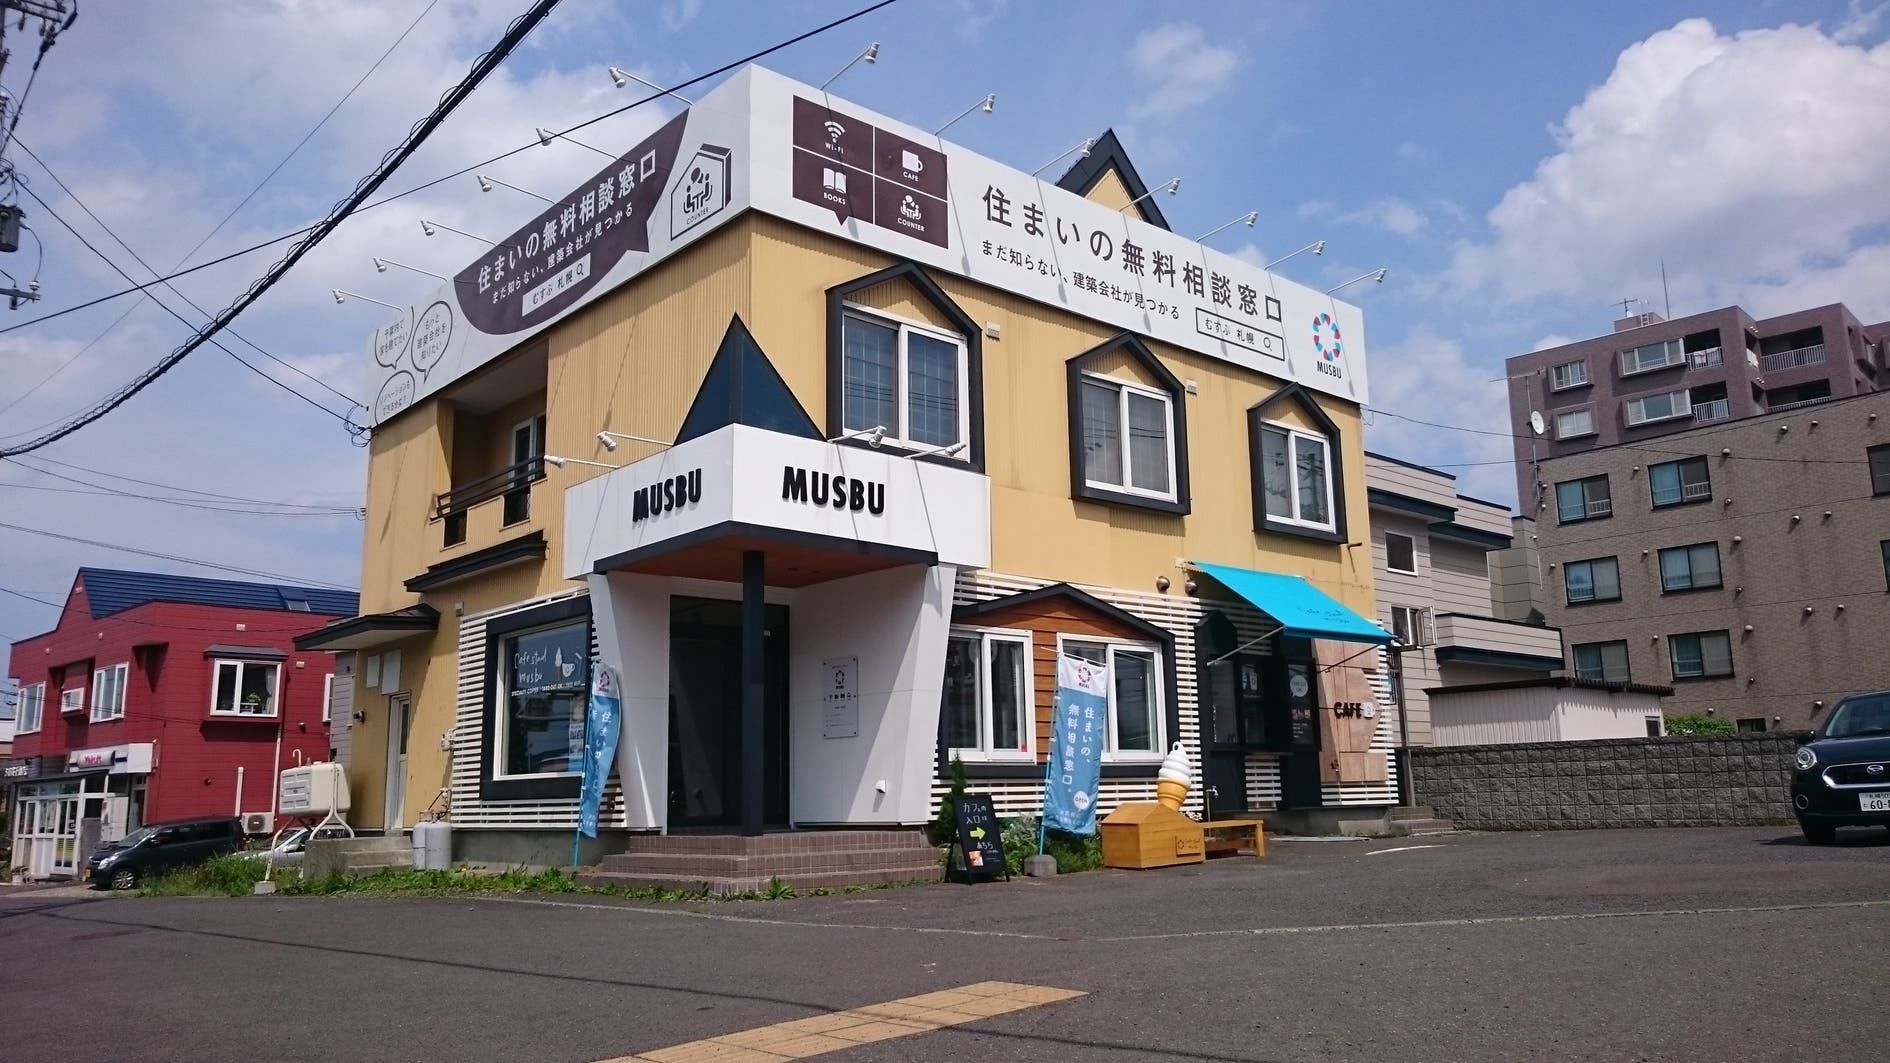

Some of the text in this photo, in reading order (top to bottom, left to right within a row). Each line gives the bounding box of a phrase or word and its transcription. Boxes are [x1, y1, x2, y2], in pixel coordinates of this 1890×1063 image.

[902, 171, 919, 182] CAFE
[823, 192, 847, 205] BOOKS
[478, 148, 656, 295] 住まいの無料相談窓口
[686, 206, 709, 225] COUNTER
[897, 217, 925, 232] COUNTER
[491, 202, 633, 304] まだ知らない、建築会社が見つかる
[982, 184, 1283, 324] 住まいの無料相談窓口
[557, 269, 573, 290] 札幌
[981, 239, 1180, 320] まだ知らない、建築会社が見つかる
[1204, 317, 1255, 345] むすぶ 札幌
[1316, 360, 1342, 379] MUSBU
[632, 467, 702, 522] MUSBU
[782, 465, 885, 515] MUSBU
[1333, 702, 1362, 719] CAFE
[962, 802, 987, 814] カフェの
